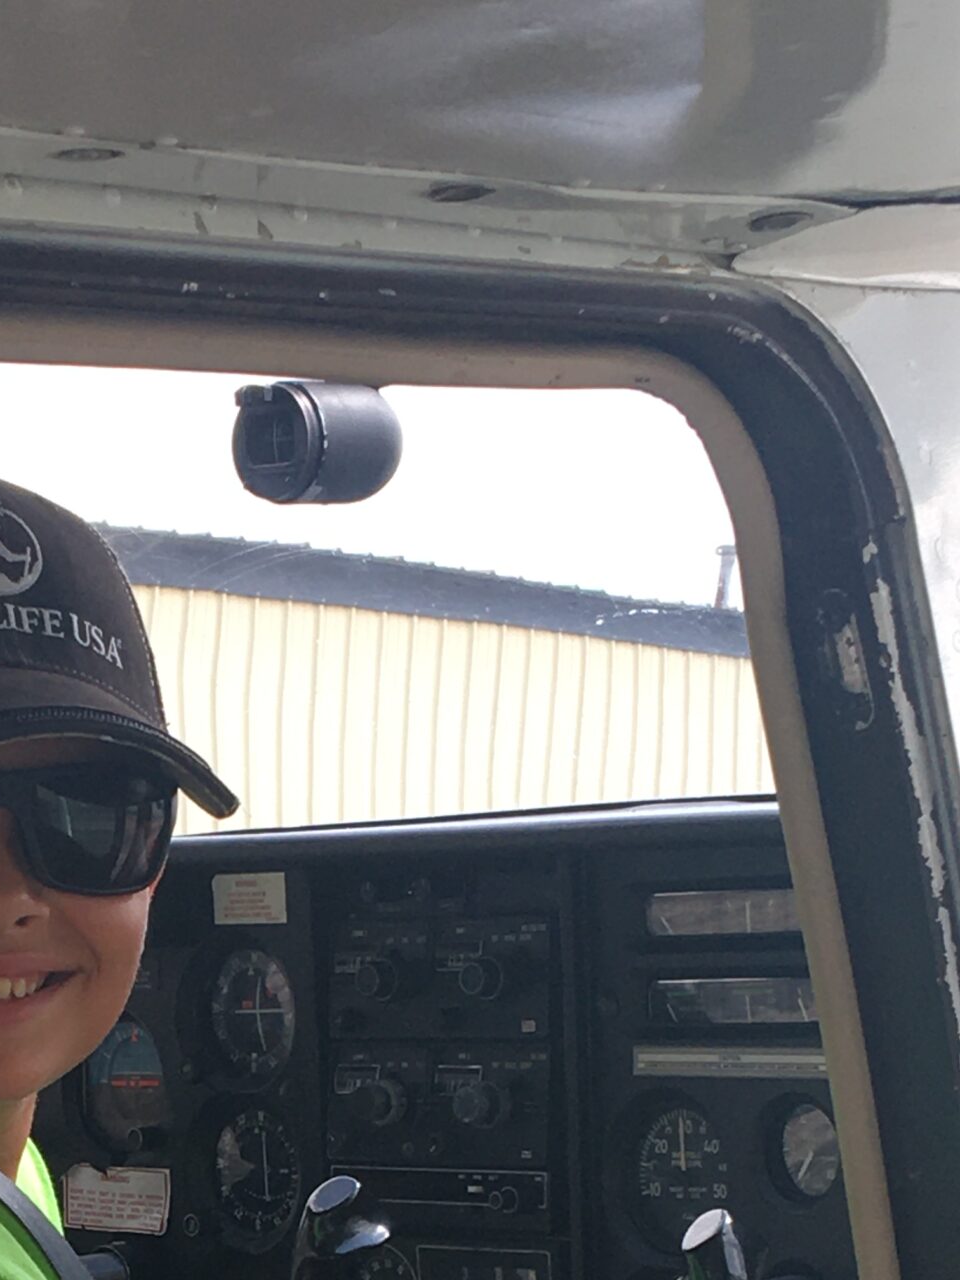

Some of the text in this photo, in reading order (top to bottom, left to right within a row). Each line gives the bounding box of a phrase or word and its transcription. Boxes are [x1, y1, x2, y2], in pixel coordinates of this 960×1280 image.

[69, 612, 123, 670] USA
[703, 1139, 719, 1155] 40
[712, 1183, 728, 1199] 50
